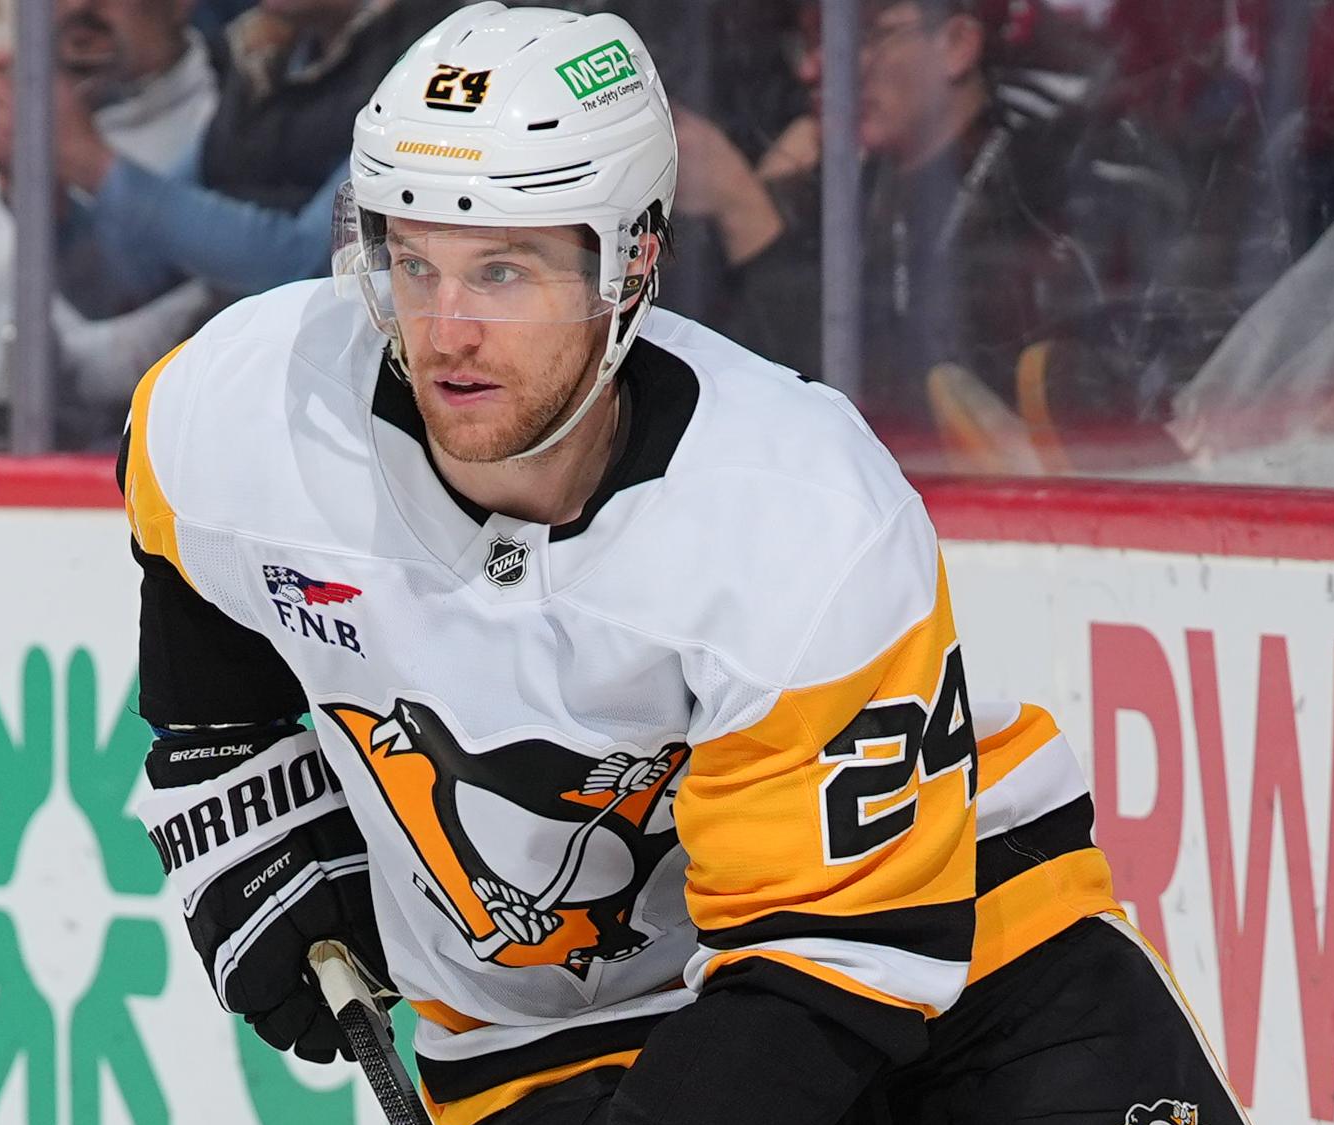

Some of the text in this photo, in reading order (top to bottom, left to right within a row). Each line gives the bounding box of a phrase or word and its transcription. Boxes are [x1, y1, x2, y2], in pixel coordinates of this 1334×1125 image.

[424, 64, 492, 106] 24
[563, 45, 633, 94] MSA
[581, 80, 644, 112] The Safety Company
[395, 141, 483, 161] WARRIOR
[492, 552, 522, 575] NHL
[271, 599, 366, 659] F.N.B.
[169, 743, 254, 763] GRZELCYK
[820, 641, 977, 864] 24
[243, 852, 292, 898] COVERT
